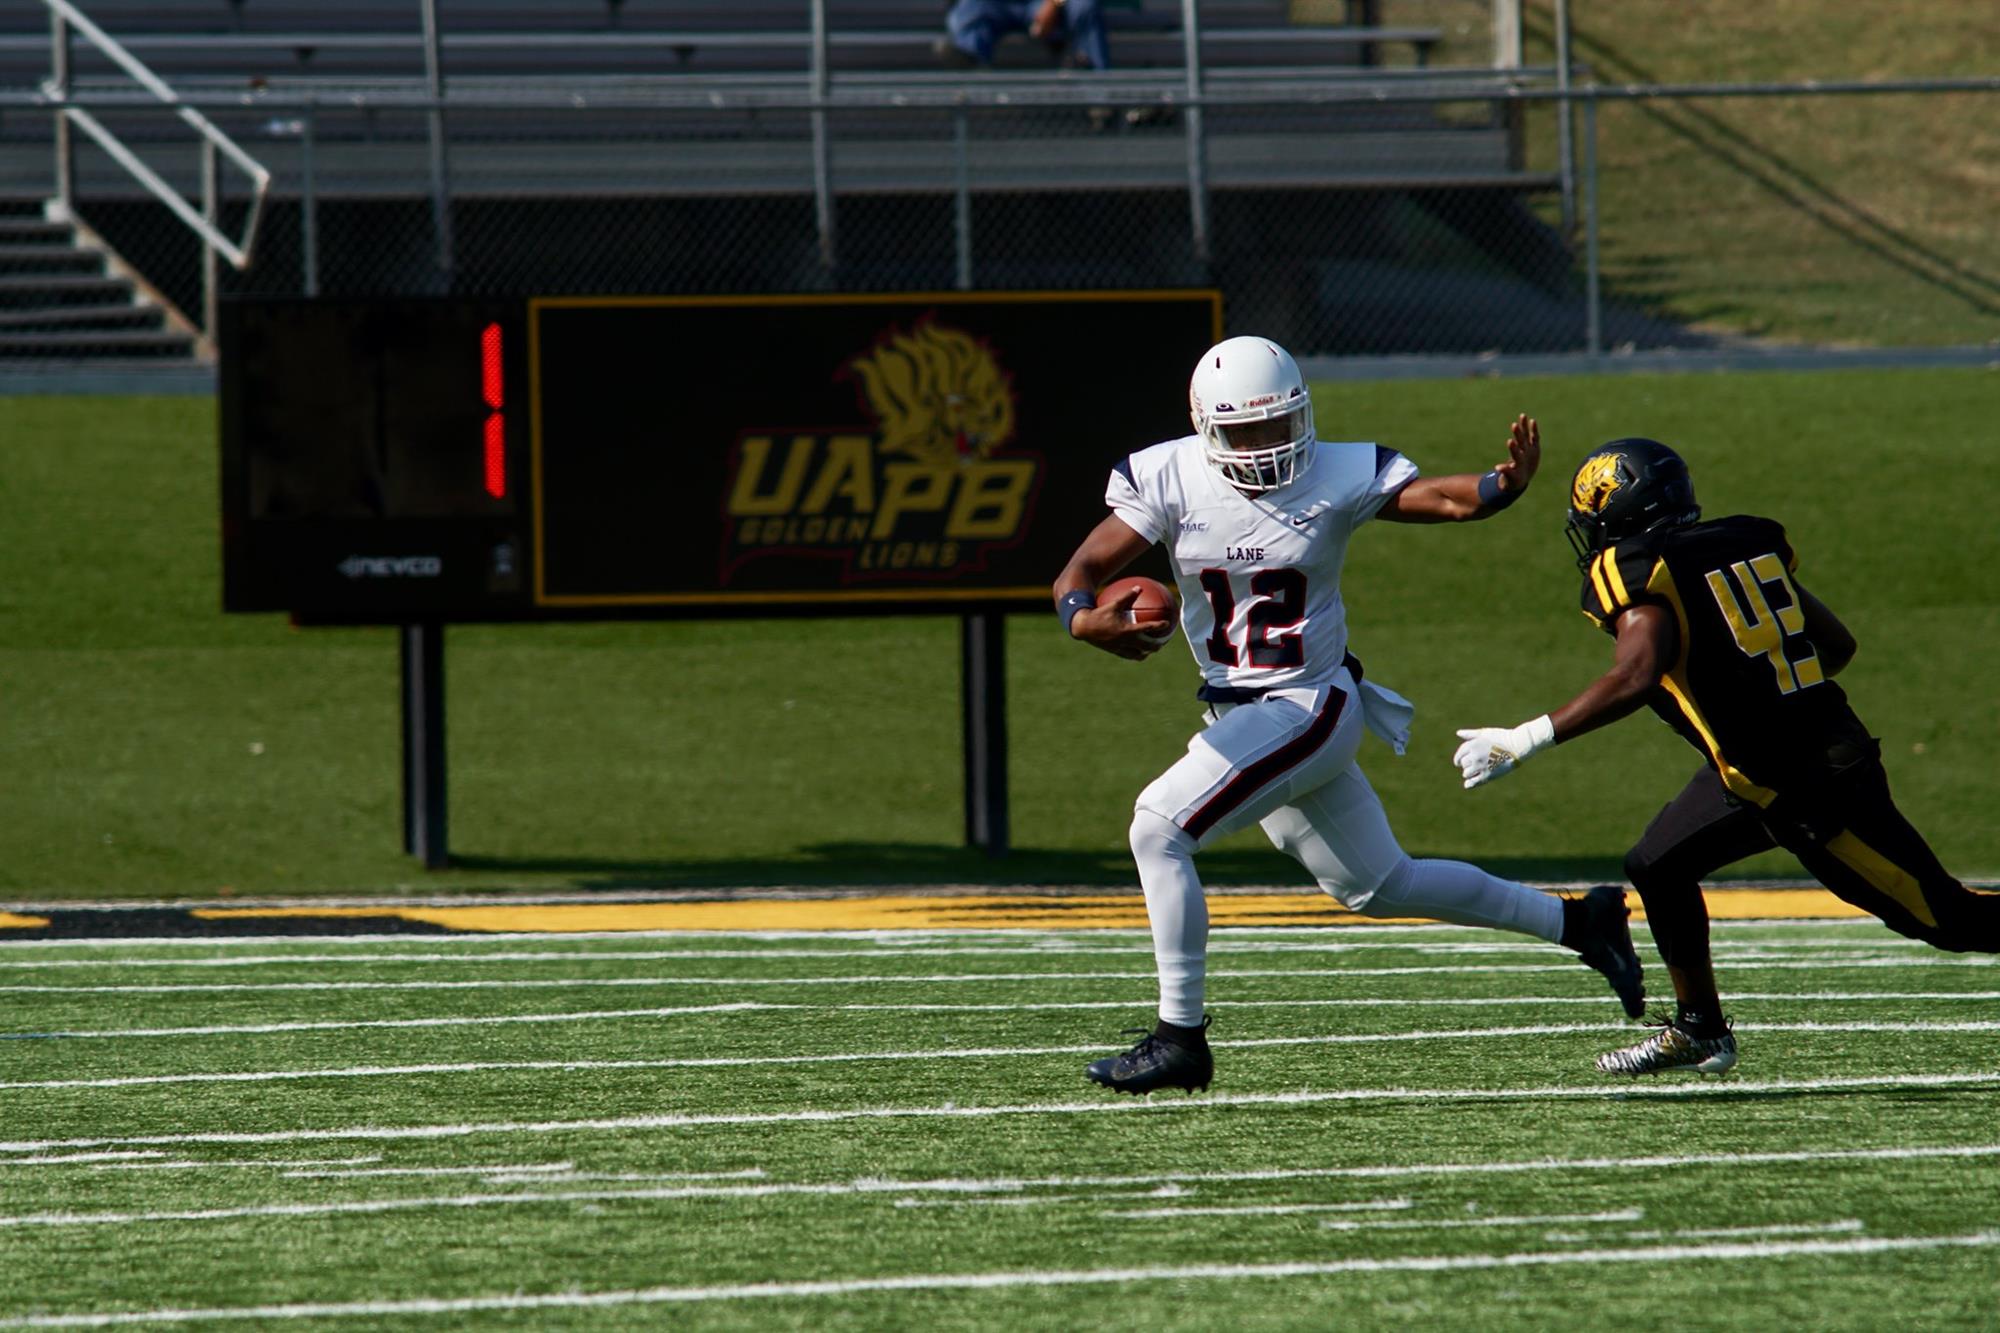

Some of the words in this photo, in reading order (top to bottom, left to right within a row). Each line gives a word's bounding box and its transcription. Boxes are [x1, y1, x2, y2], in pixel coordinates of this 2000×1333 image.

[727, 435, 1037, 540] UAPB
[738, 517, 870, 544] GOLDEN
[859, 541, 960, 570] LIONS
[1226, 547, 1265, 560] LANE
[1200, 567, 1308, 669] 12
